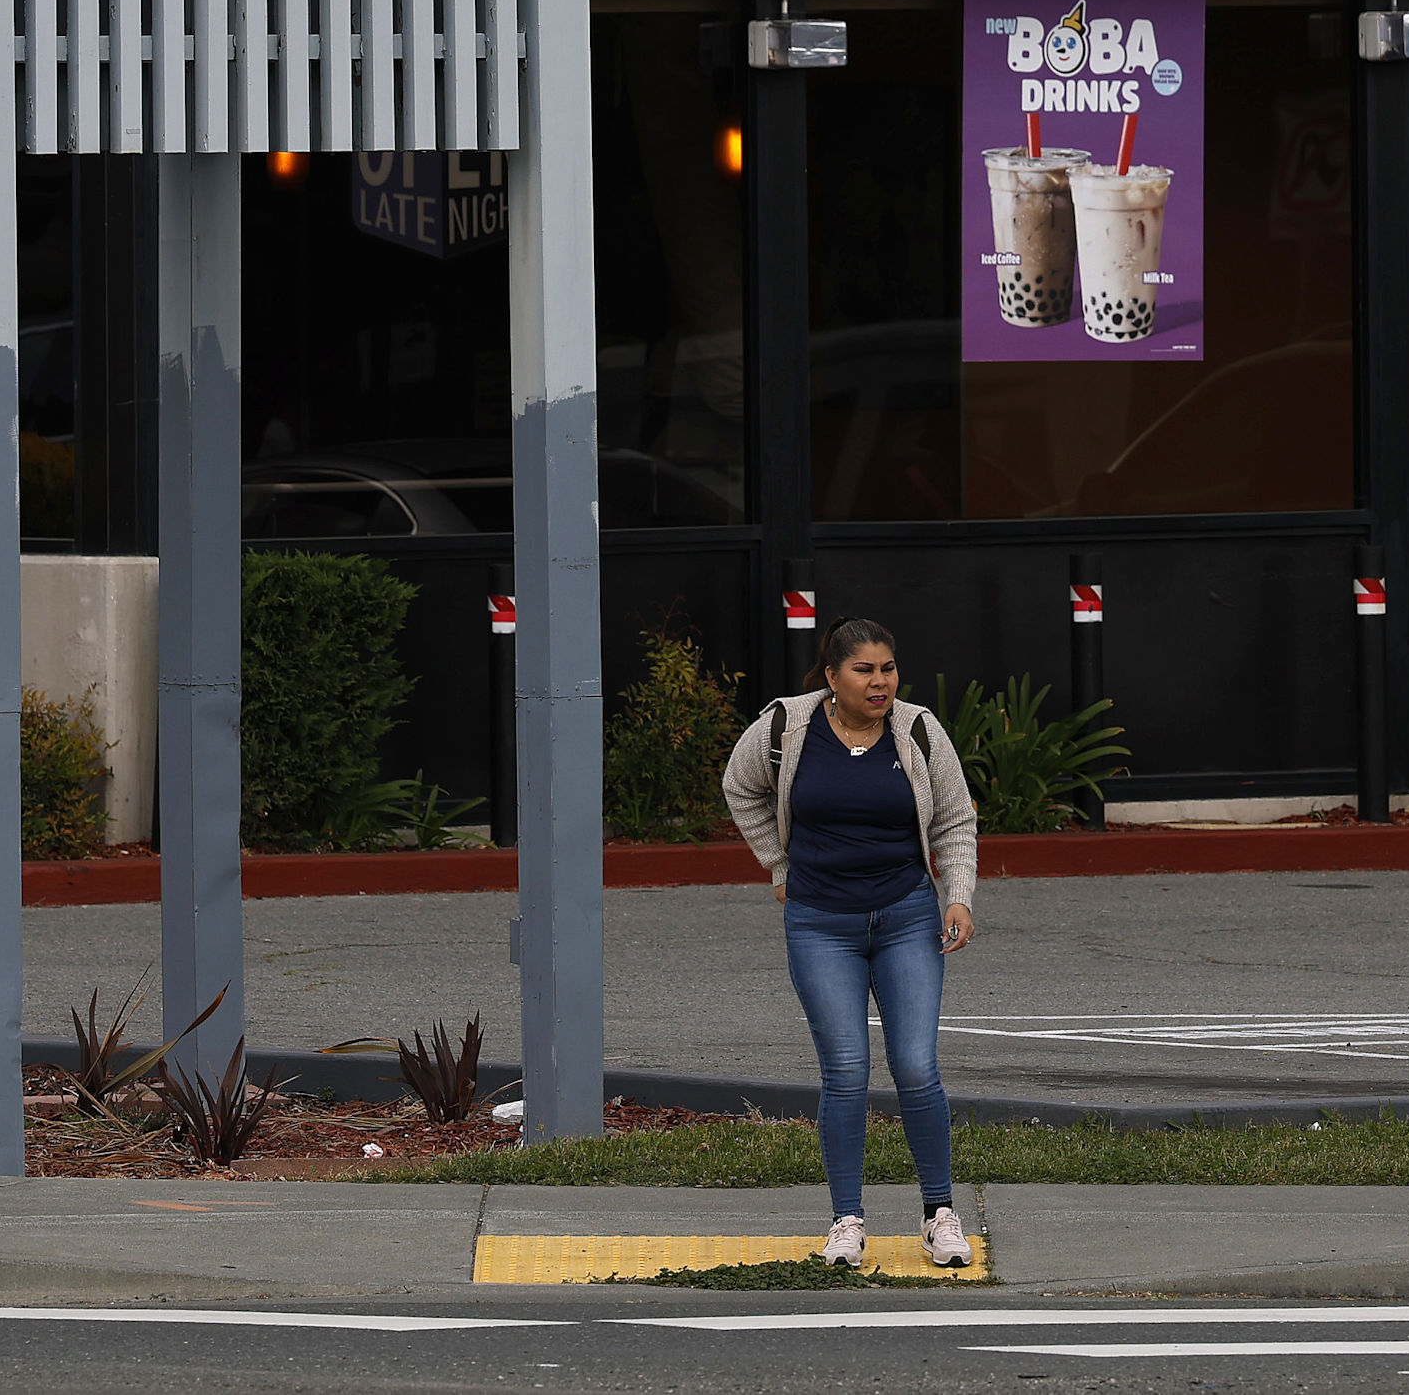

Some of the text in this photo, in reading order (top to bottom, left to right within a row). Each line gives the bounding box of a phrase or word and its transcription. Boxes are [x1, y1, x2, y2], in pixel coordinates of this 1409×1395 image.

[986, 17, 1017, 34] new
[1022, 79, 1141, 113] DRINKS
[360, 188, 509, 245] LATE NIGH
[981, 253, 1021, 265] Iced Coffee
[1143, 272, 1175, 284] Milk Tea
